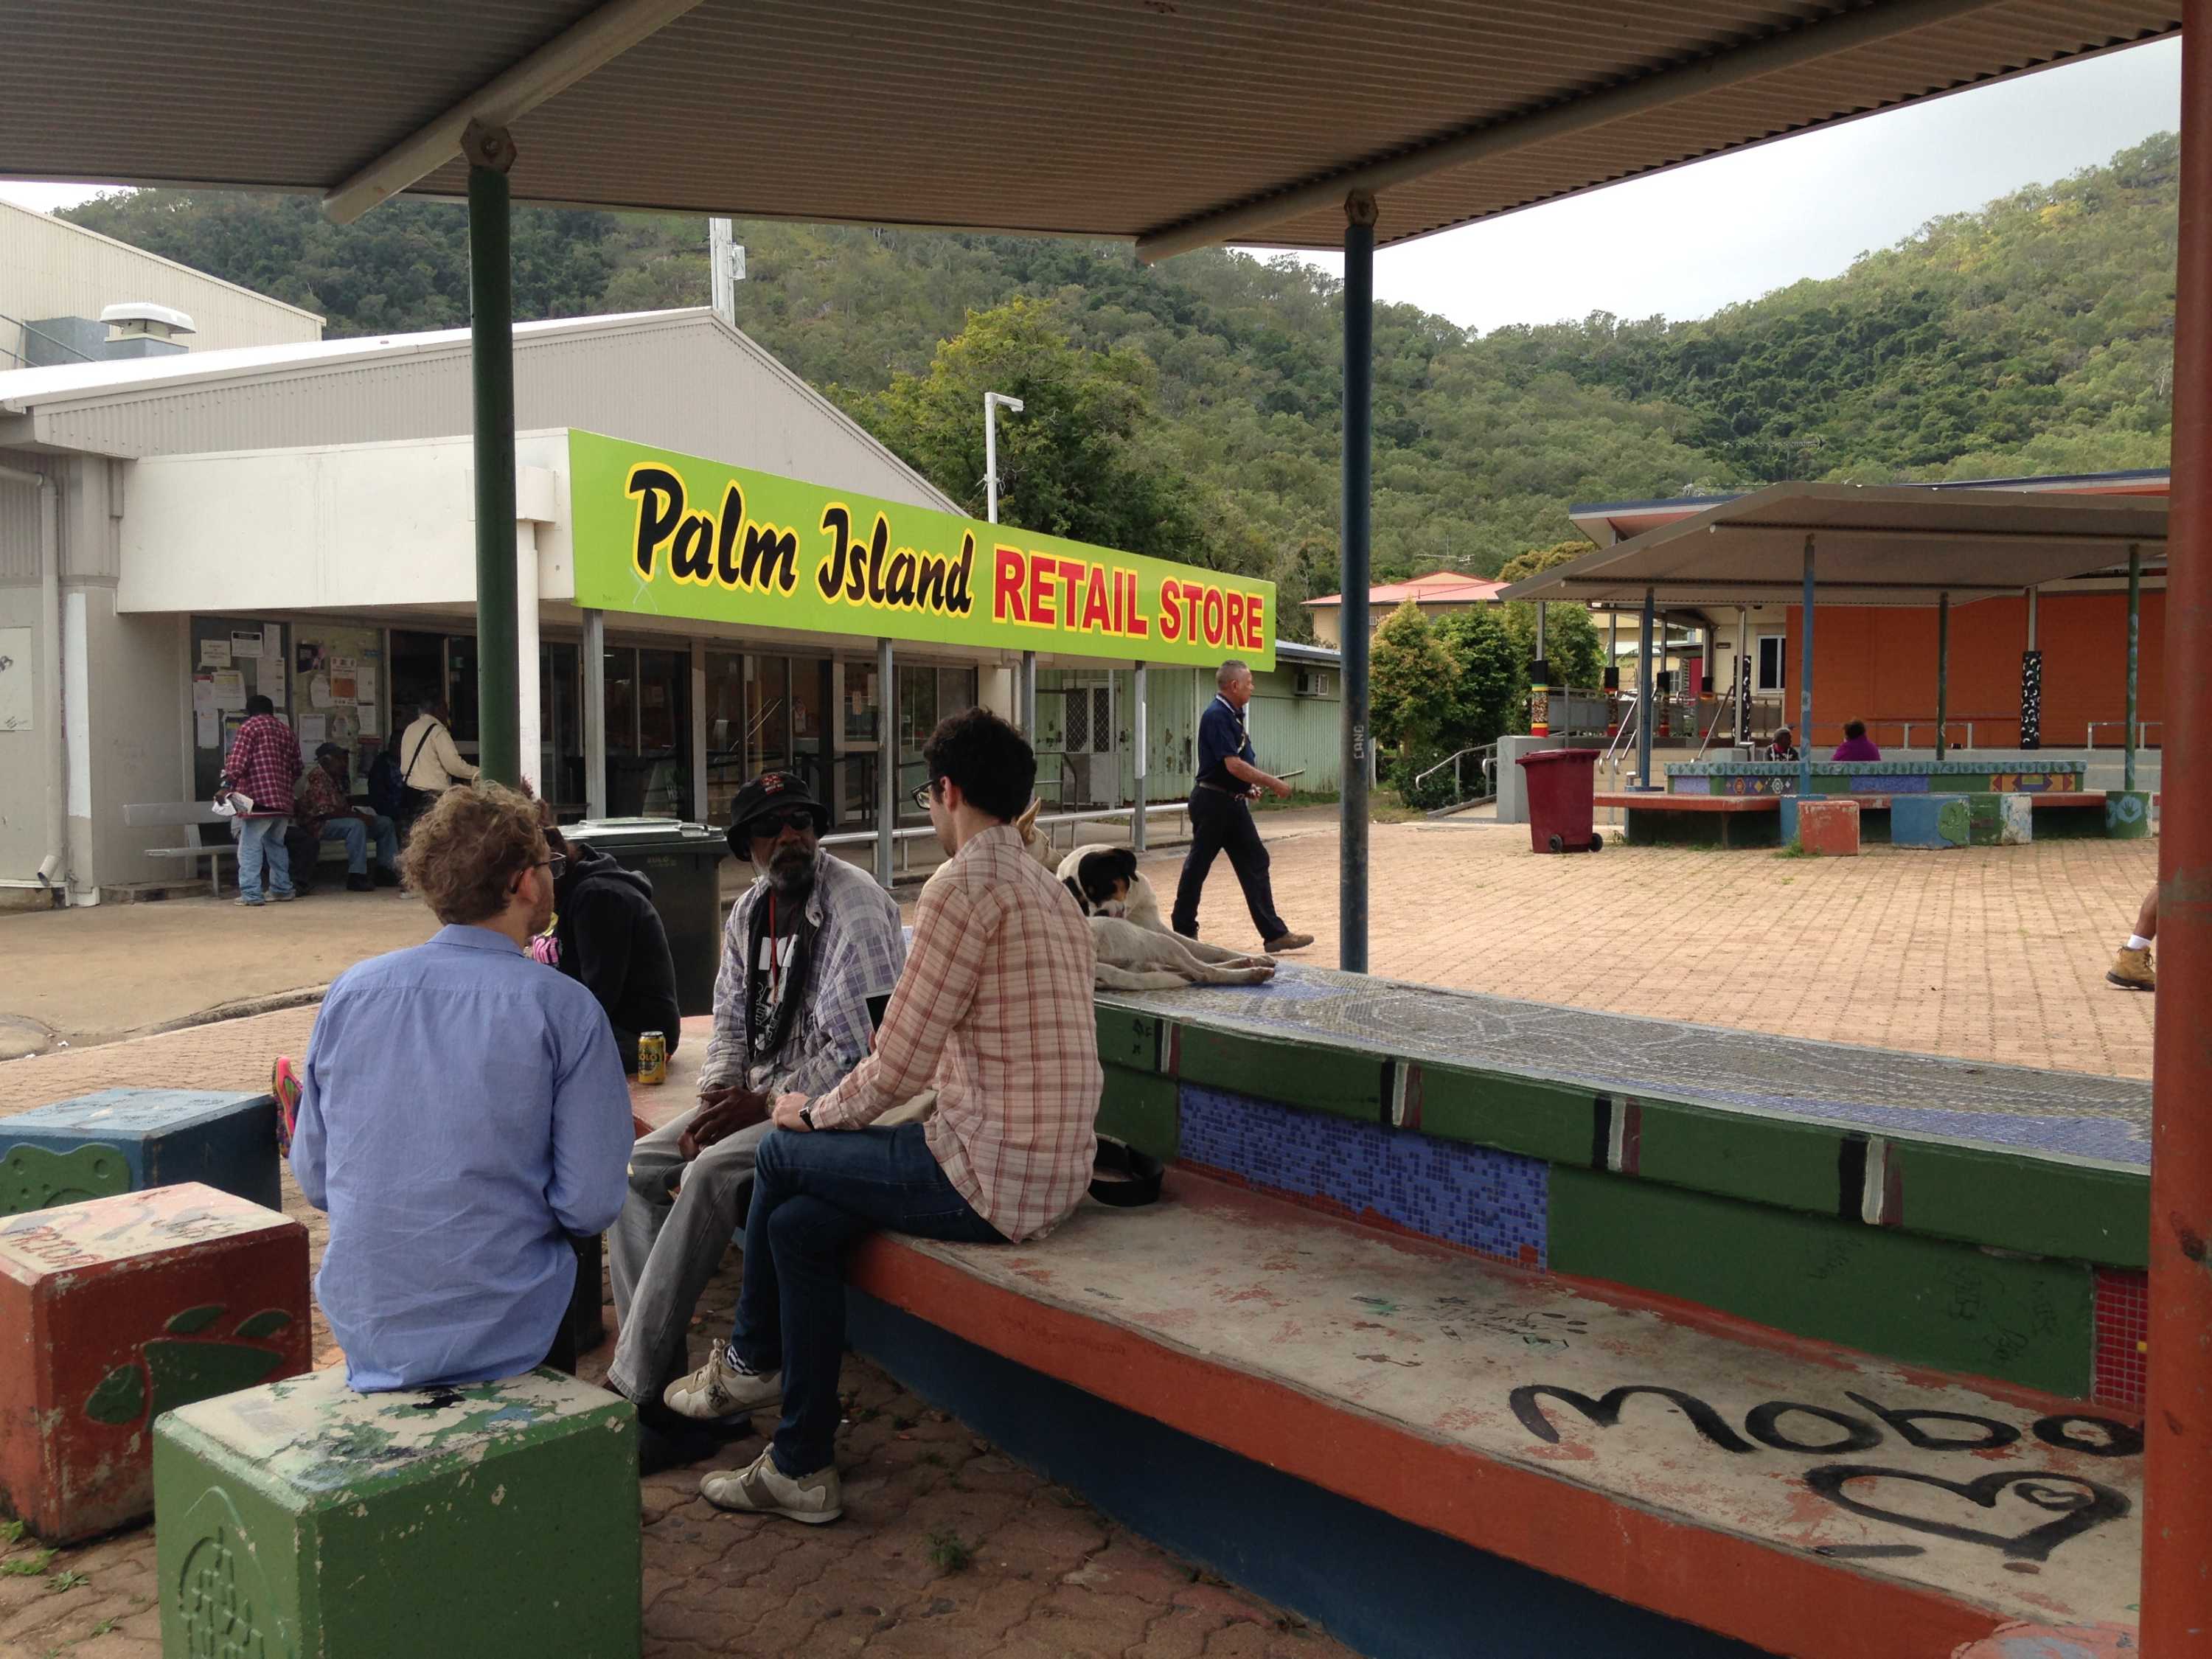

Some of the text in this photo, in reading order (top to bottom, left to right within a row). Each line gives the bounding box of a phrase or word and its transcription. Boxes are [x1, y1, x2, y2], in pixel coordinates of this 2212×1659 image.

[625, 461, 1265, 653] Palm Island RETAIL STORE
